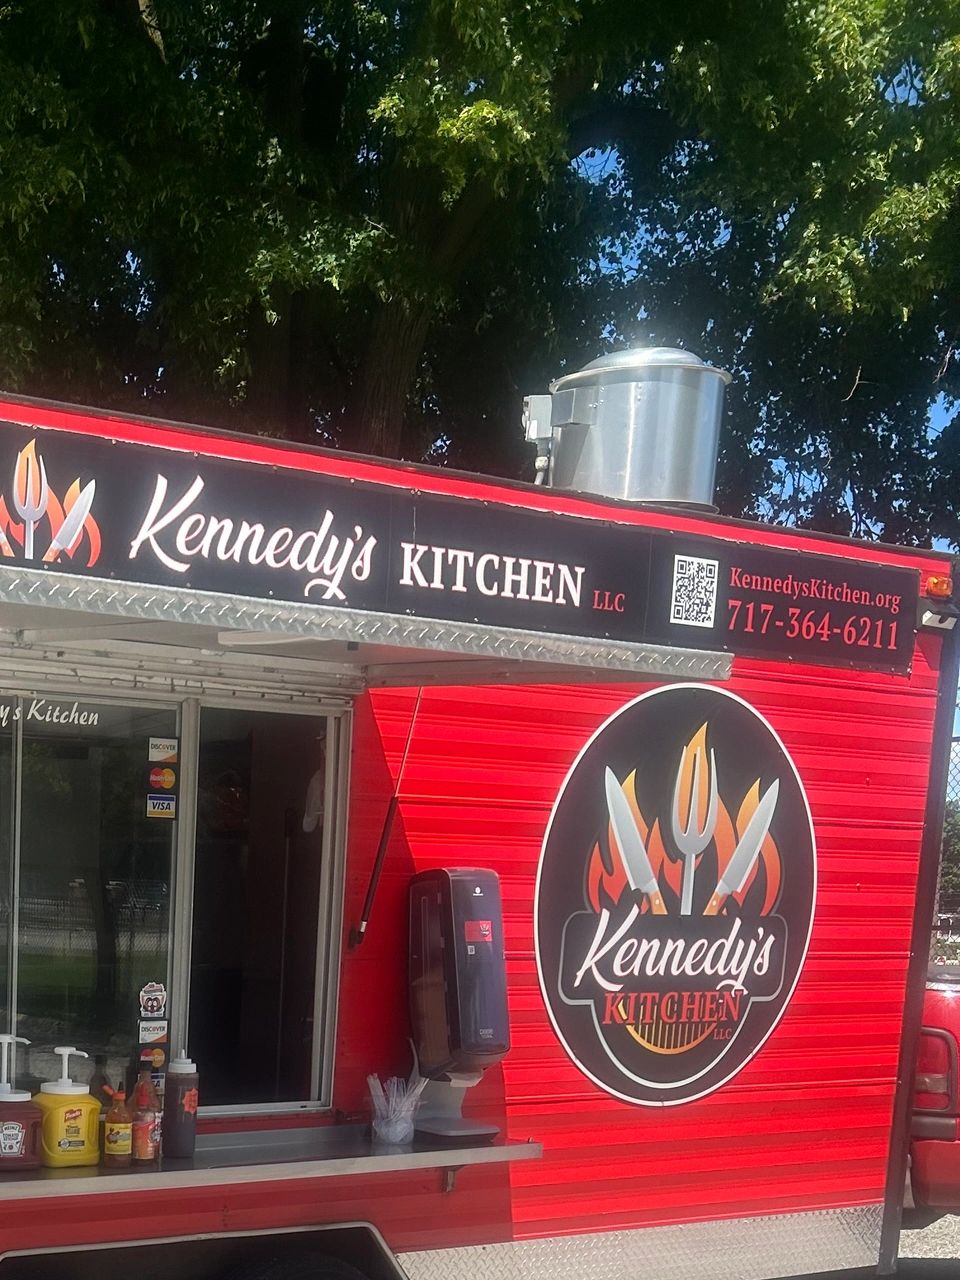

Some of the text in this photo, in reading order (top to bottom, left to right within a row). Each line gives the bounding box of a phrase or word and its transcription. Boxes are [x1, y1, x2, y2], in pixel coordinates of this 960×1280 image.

[128, 473, 626, 613] Kennedy's KITCHEN LLC
[729, 567, 902, 615] KennedysKitchen.org
[727, 599, 898, 650] 717-364-6211
[26, 699, 100, 726] Kitchen
[150, 743, 176, 751] DISCOVER
[151, 802, 171, 811] VISA
[573, 903, 776, 998] Kennedy's
[601, 988, 746, 1026] KITCHEN
[712, 1027, 733, 1041] LLC
